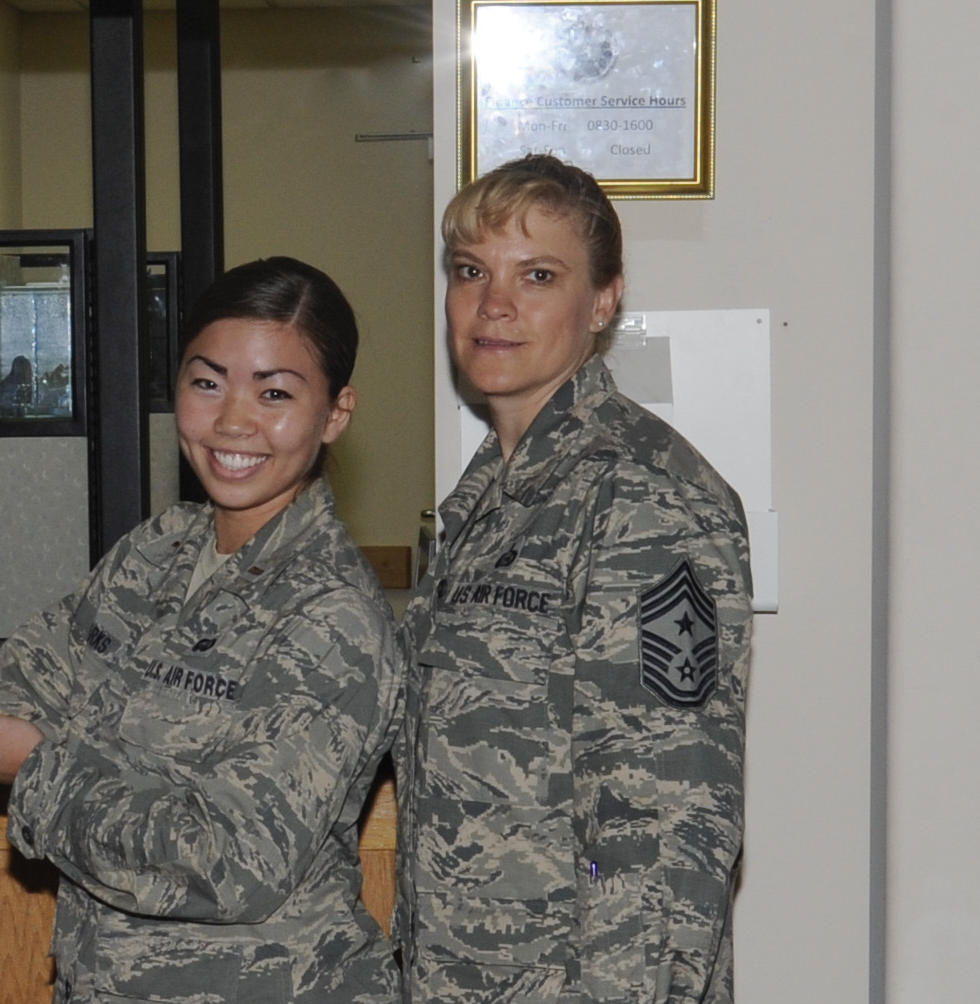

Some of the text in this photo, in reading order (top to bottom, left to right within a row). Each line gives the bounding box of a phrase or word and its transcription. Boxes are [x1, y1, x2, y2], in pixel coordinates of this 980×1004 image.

[537, 96, 597, 107] Customer
[601, 95, 645, 107] Service
[649, 95, 686, 107] Hours
[587, 119, 653, 132] 0830-1600
[610, 143, 651, 156] Closed
[470, 584, 492, 604] AIR
[493, 585, 551, 614] FORCE
[162, 666, 184, 688] AIR
[184, 671, 239, 700] FORCE
